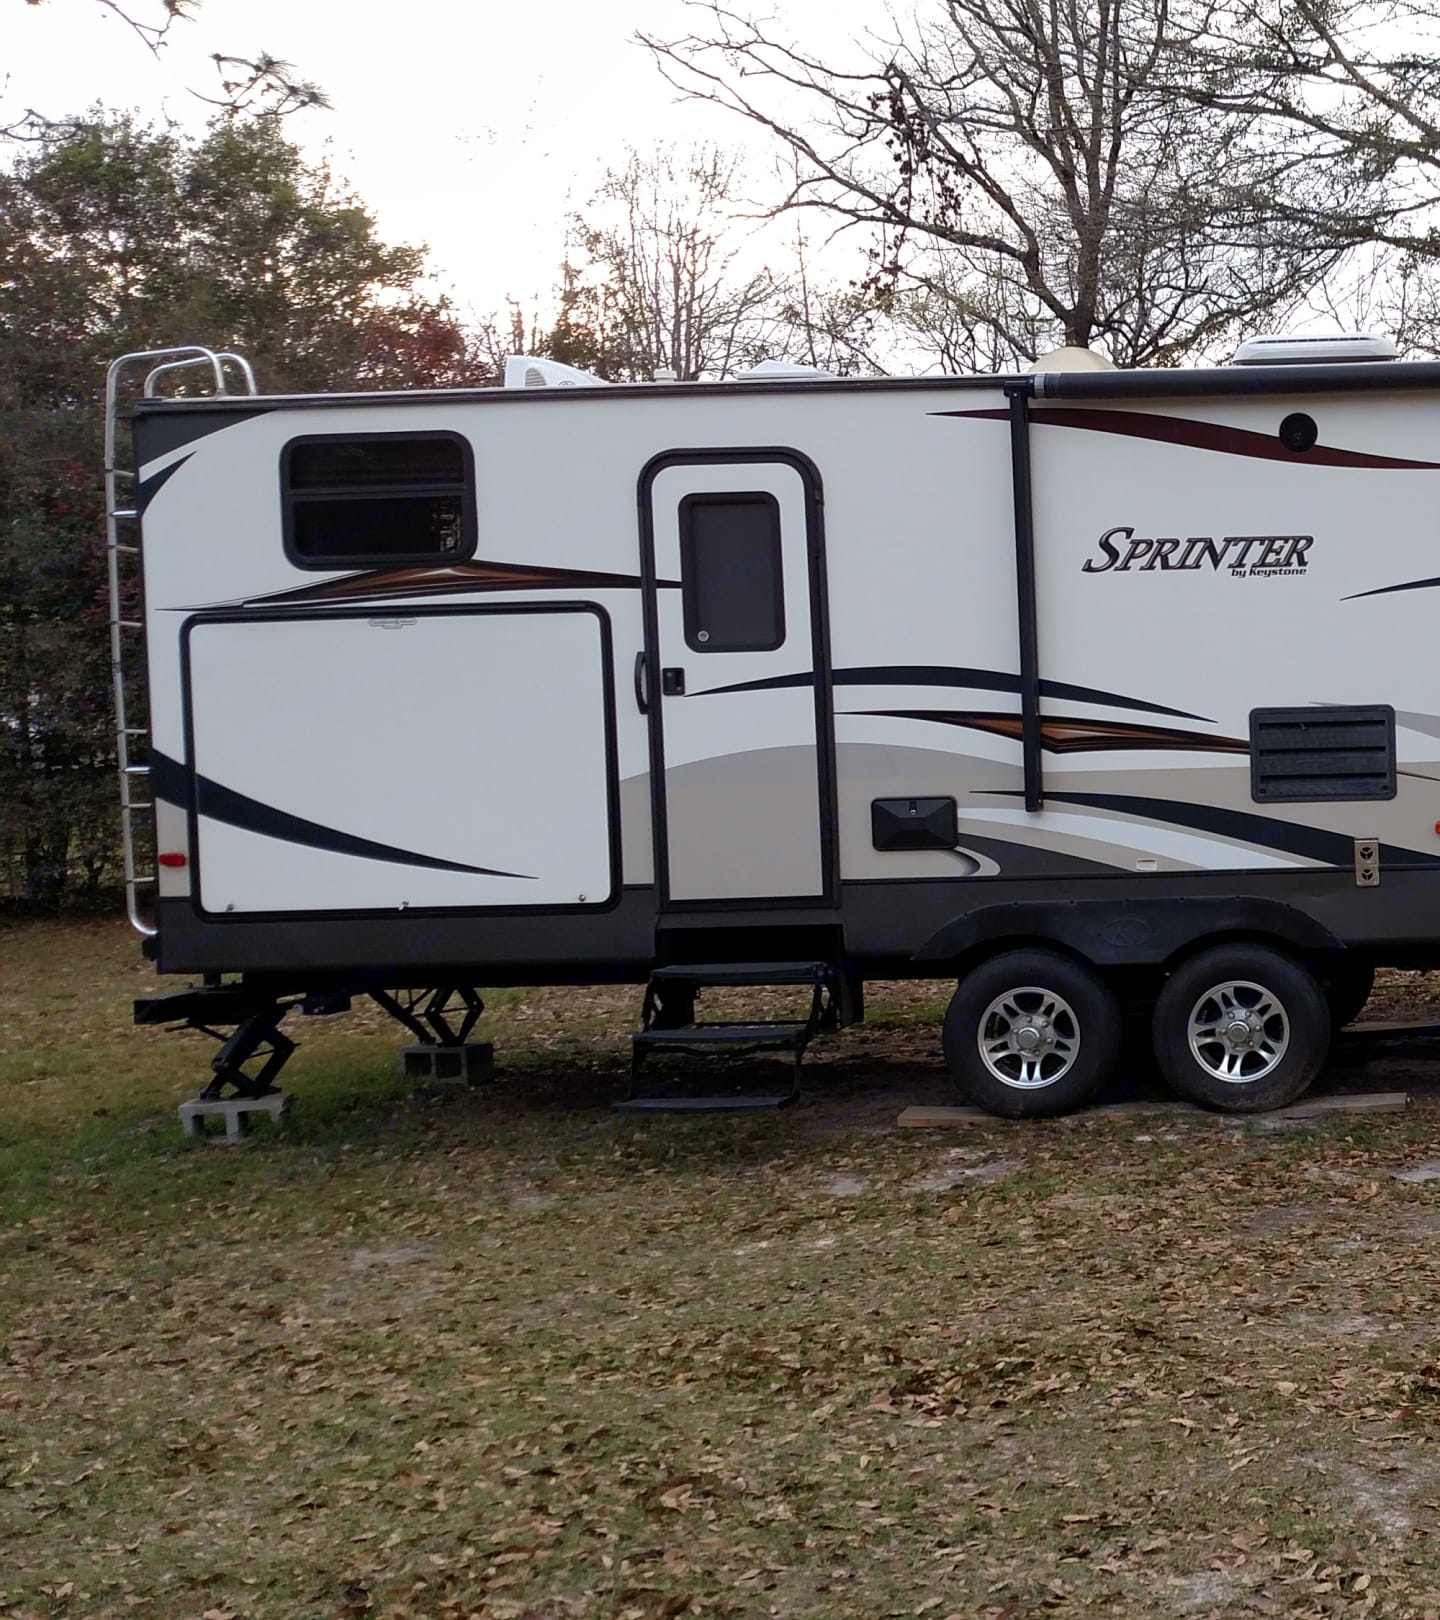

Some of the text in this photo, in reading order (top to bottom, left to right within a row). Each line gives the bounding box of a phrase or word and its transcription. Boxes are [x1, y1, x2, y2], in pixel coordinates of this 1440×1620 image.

[1082, 527, 1314, 572] SPRINTER
[1231, 566, 1307, 579] by Keystone
